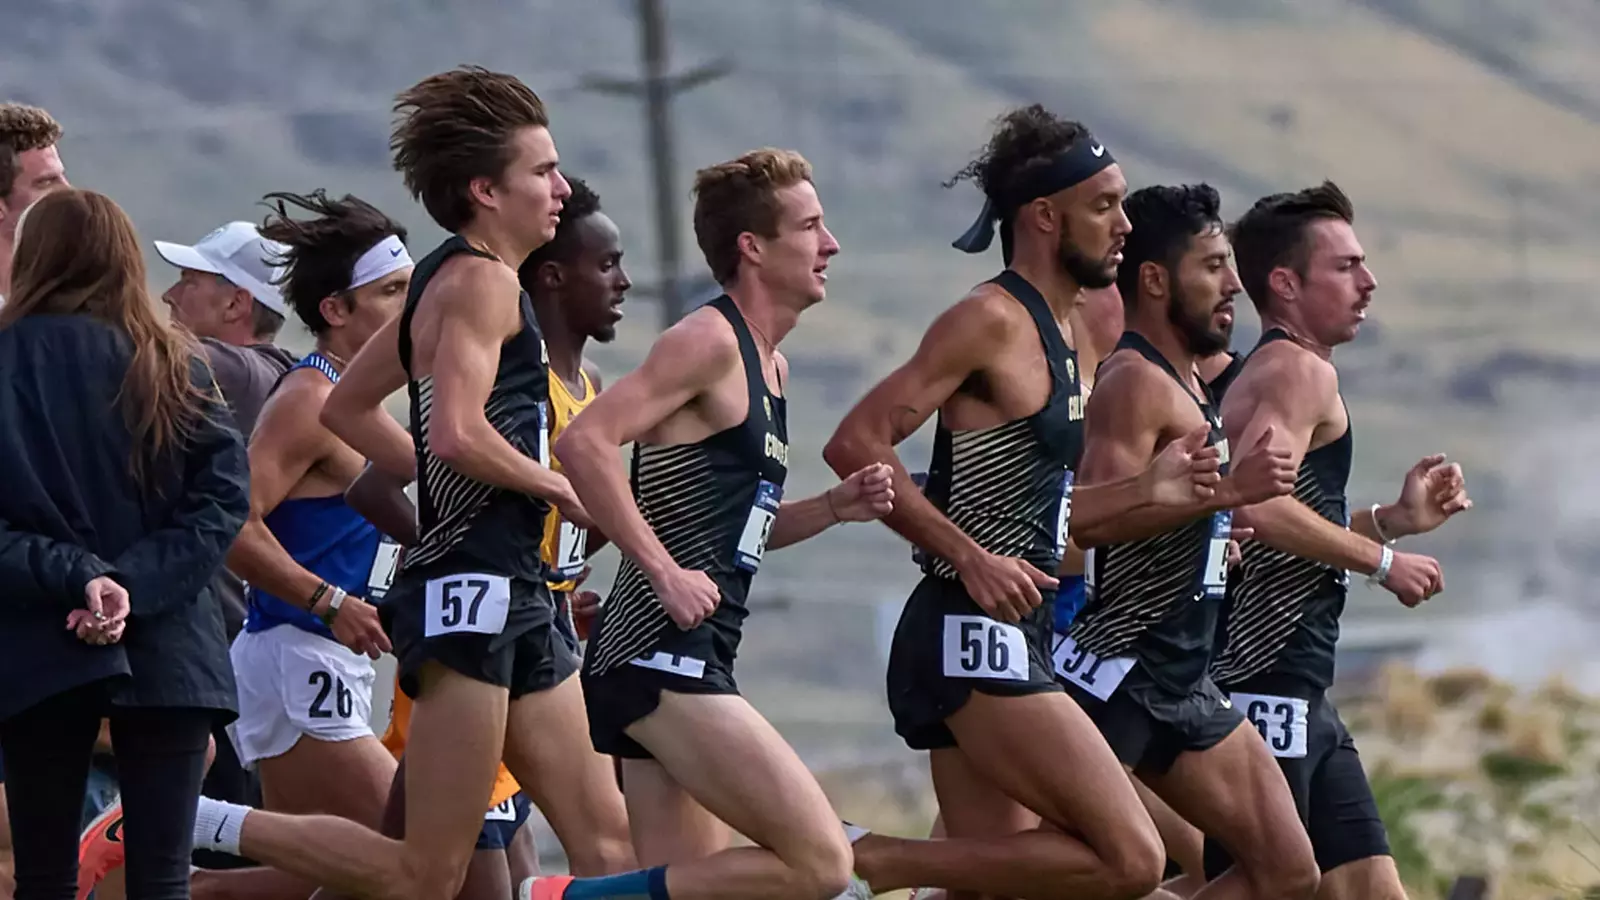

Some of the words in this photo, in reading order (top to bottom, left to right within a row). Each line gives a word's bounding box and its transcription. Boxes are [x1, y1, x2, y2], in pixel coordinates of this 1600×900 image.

[441, 580, 490, 627] 57
[960, 622, 1010, 673] 56
[308, 670, 353, 719] 26
[1247, 700, 1294, 751] 63
